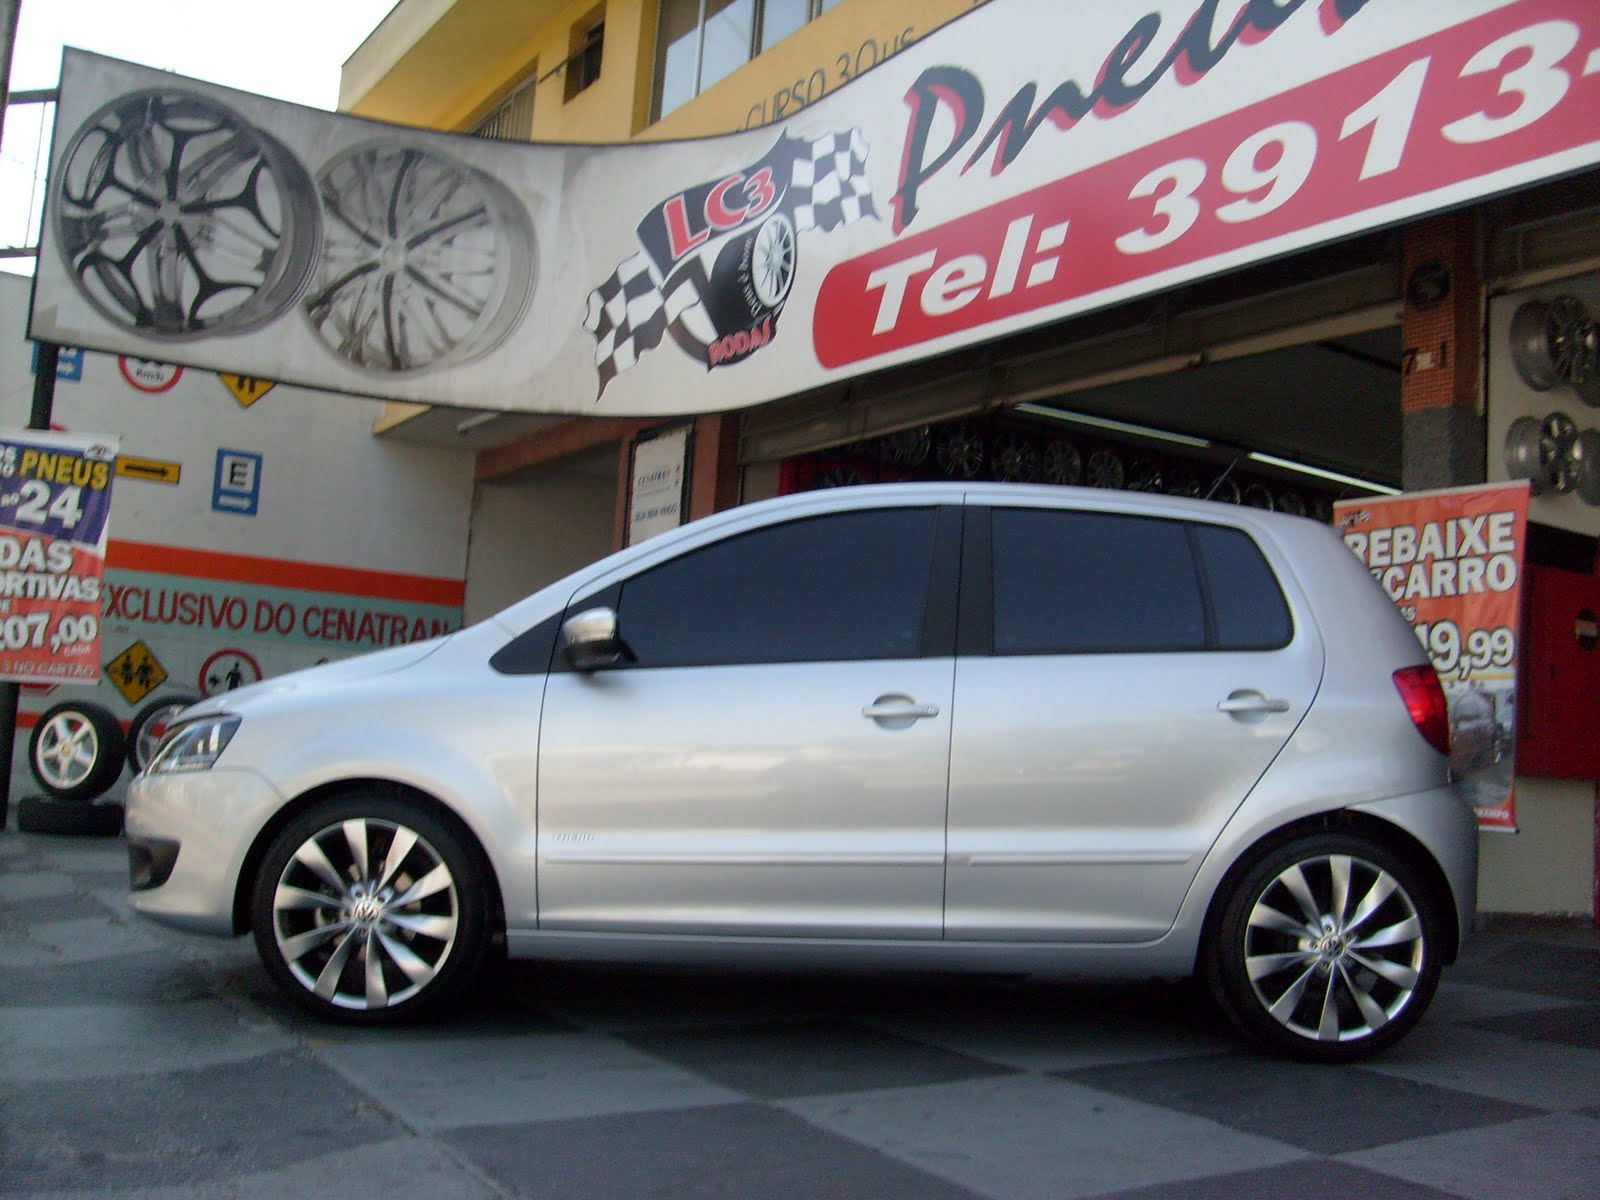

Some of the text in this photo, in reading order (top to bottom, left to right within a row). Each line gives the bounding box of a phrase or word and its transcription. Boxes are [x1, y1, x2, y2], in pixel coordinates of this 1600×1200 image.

[662, 167, 777, 261] LC3
[864, 212, 1070, 336] Tel:
[20, 448, 110, 492] PNEUS
[228, 461, 250, 488] E
[1343, 510, 1516, 566] REBAIXE
[0, 570, 101, 604] RTIVAS
[1381, 552, 1518, 602] CARRO
[0, 611, 98, 655] 07,00
[101, 583, 248, 631] XCLUSIVO
[253, 599, 297, 635] DO
